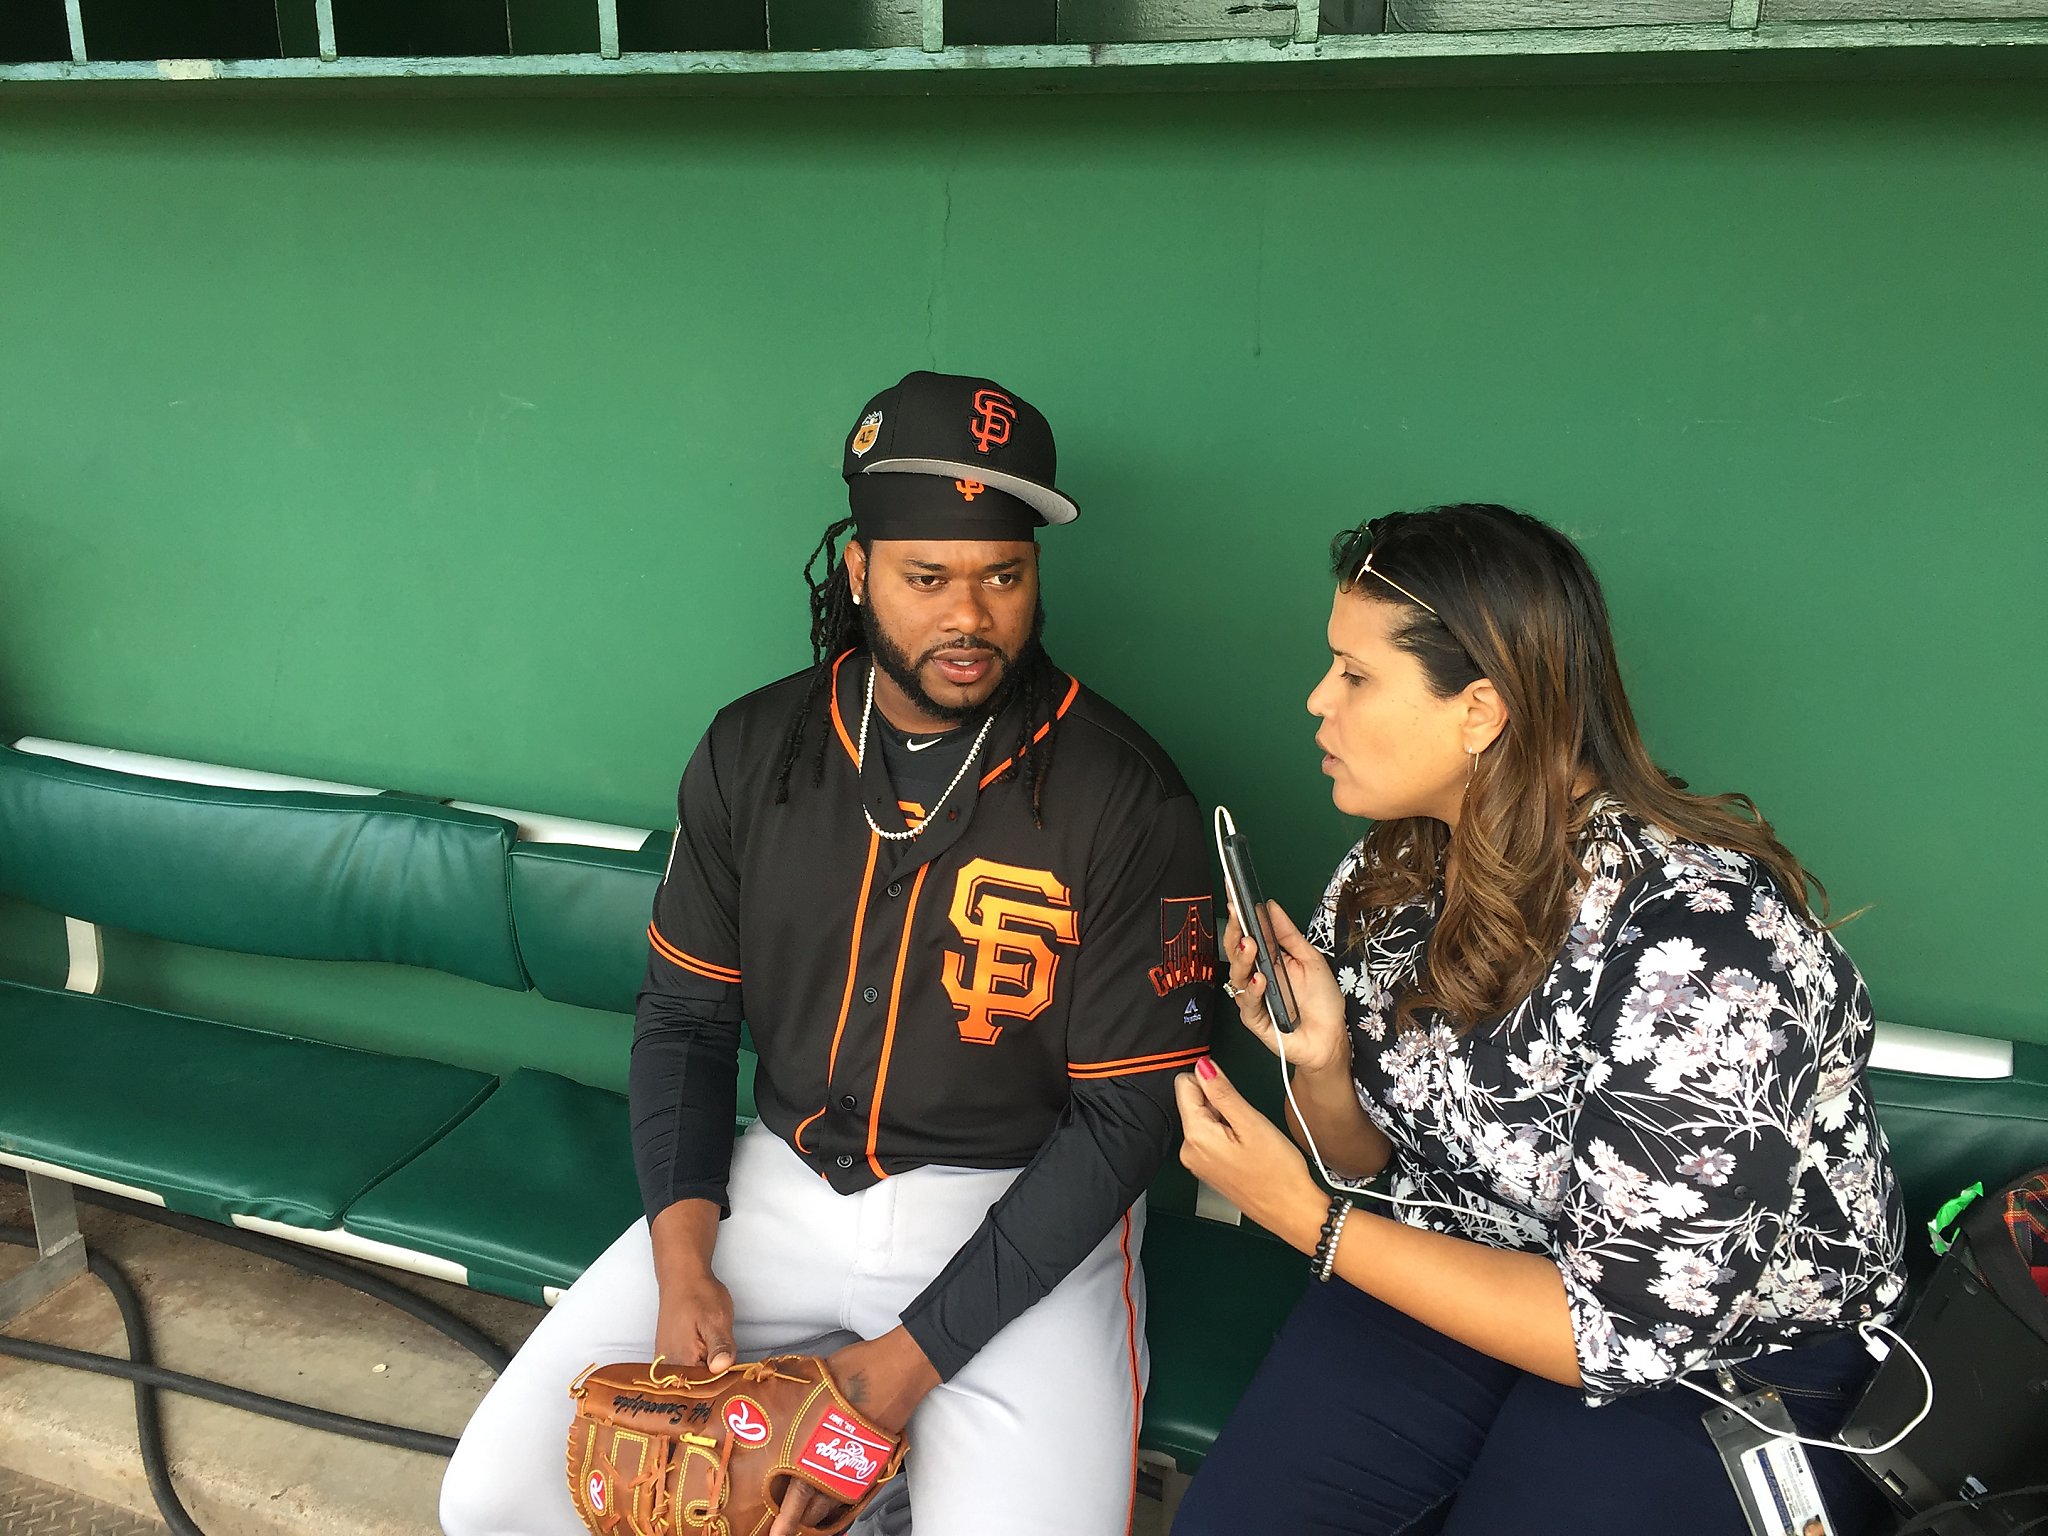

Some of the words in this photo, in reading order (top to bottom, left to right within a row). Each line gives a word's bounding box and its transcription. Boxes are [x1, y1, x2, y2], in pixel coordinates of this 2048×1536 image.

[969, 388, 1018, 453] SF
[940, 857, 1081, 1045] SF
[816, 1438, 877, 1479] Rawlings
